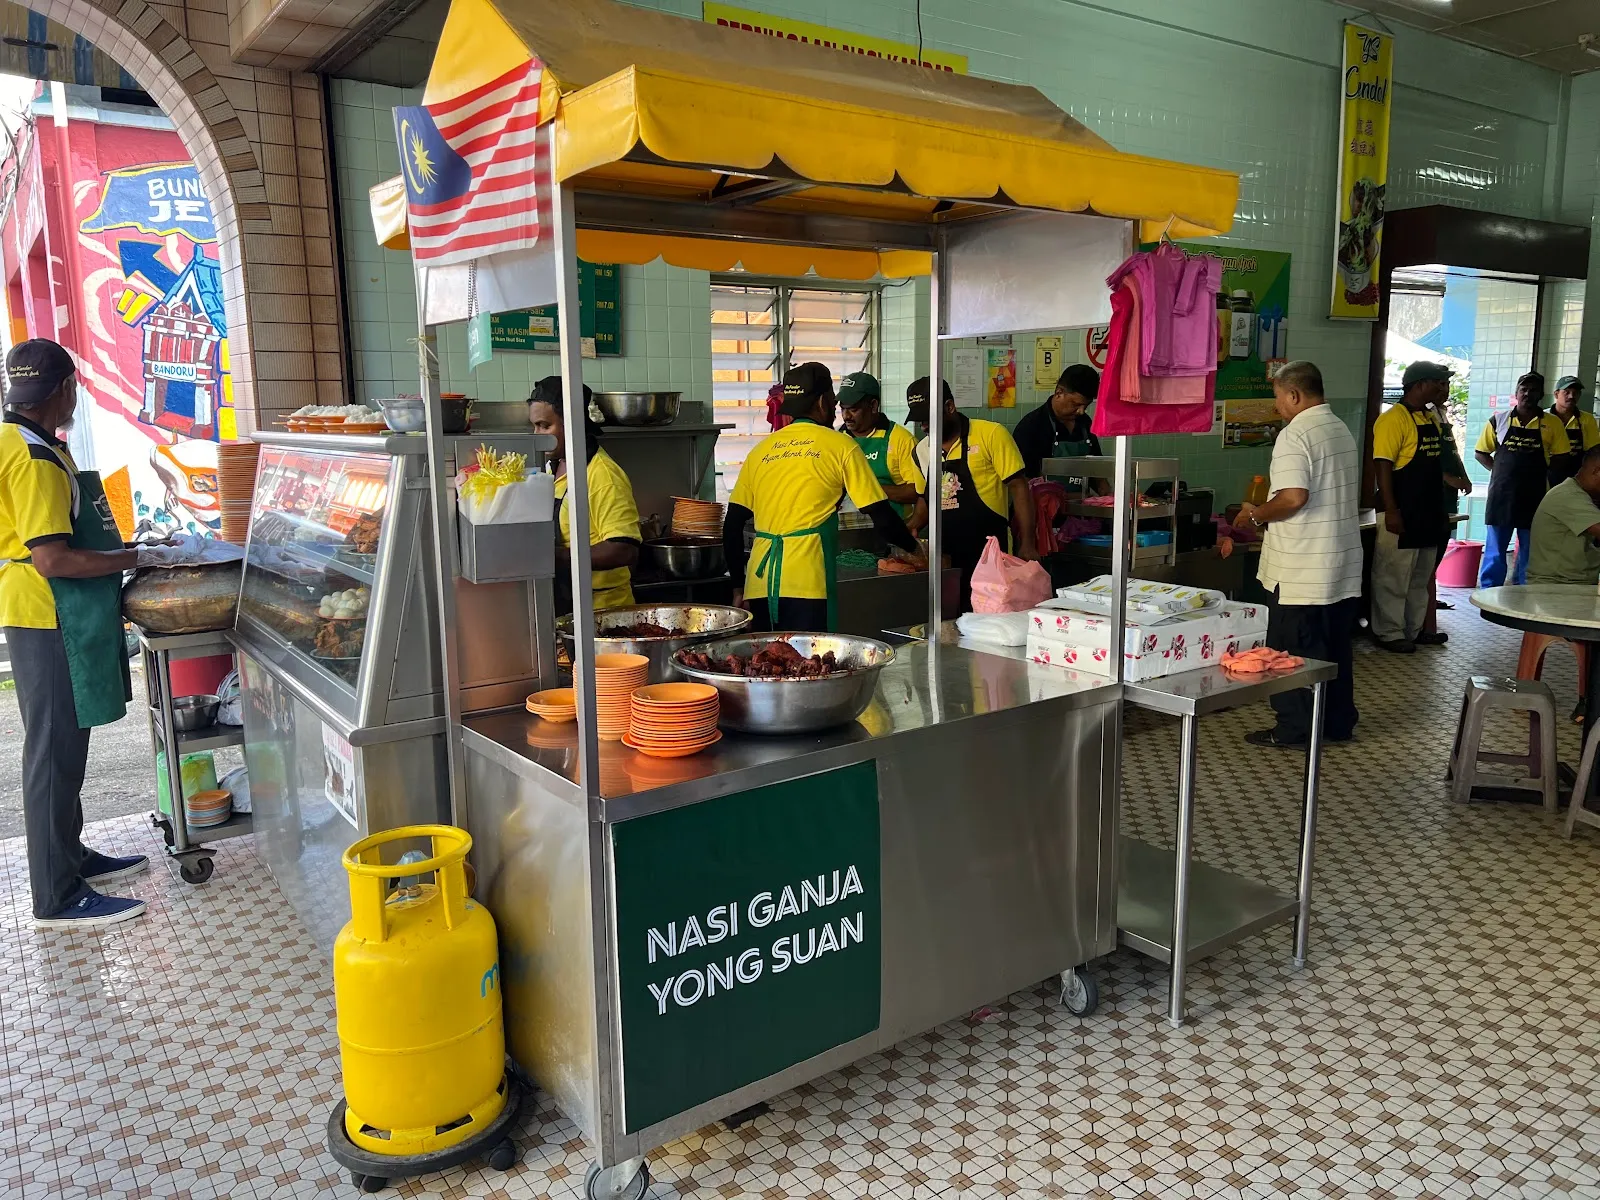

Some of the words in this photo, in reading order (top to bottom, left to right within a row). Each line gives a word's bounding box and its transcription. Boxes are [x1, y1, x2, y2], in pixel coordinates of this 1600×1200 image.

[1044, 351, 1052, 365] B
[153, 363, 195, 378] BANDORU
[771, 440, 788, 450] Nasi
[788, 437, 815, 448] Kandar
[646, 901, 738, 964] NASI
[747, 864, 864, 928] GANJA
[646, 947, 764, 1016] YONG
[771, 911, 864, 974] SUAN
